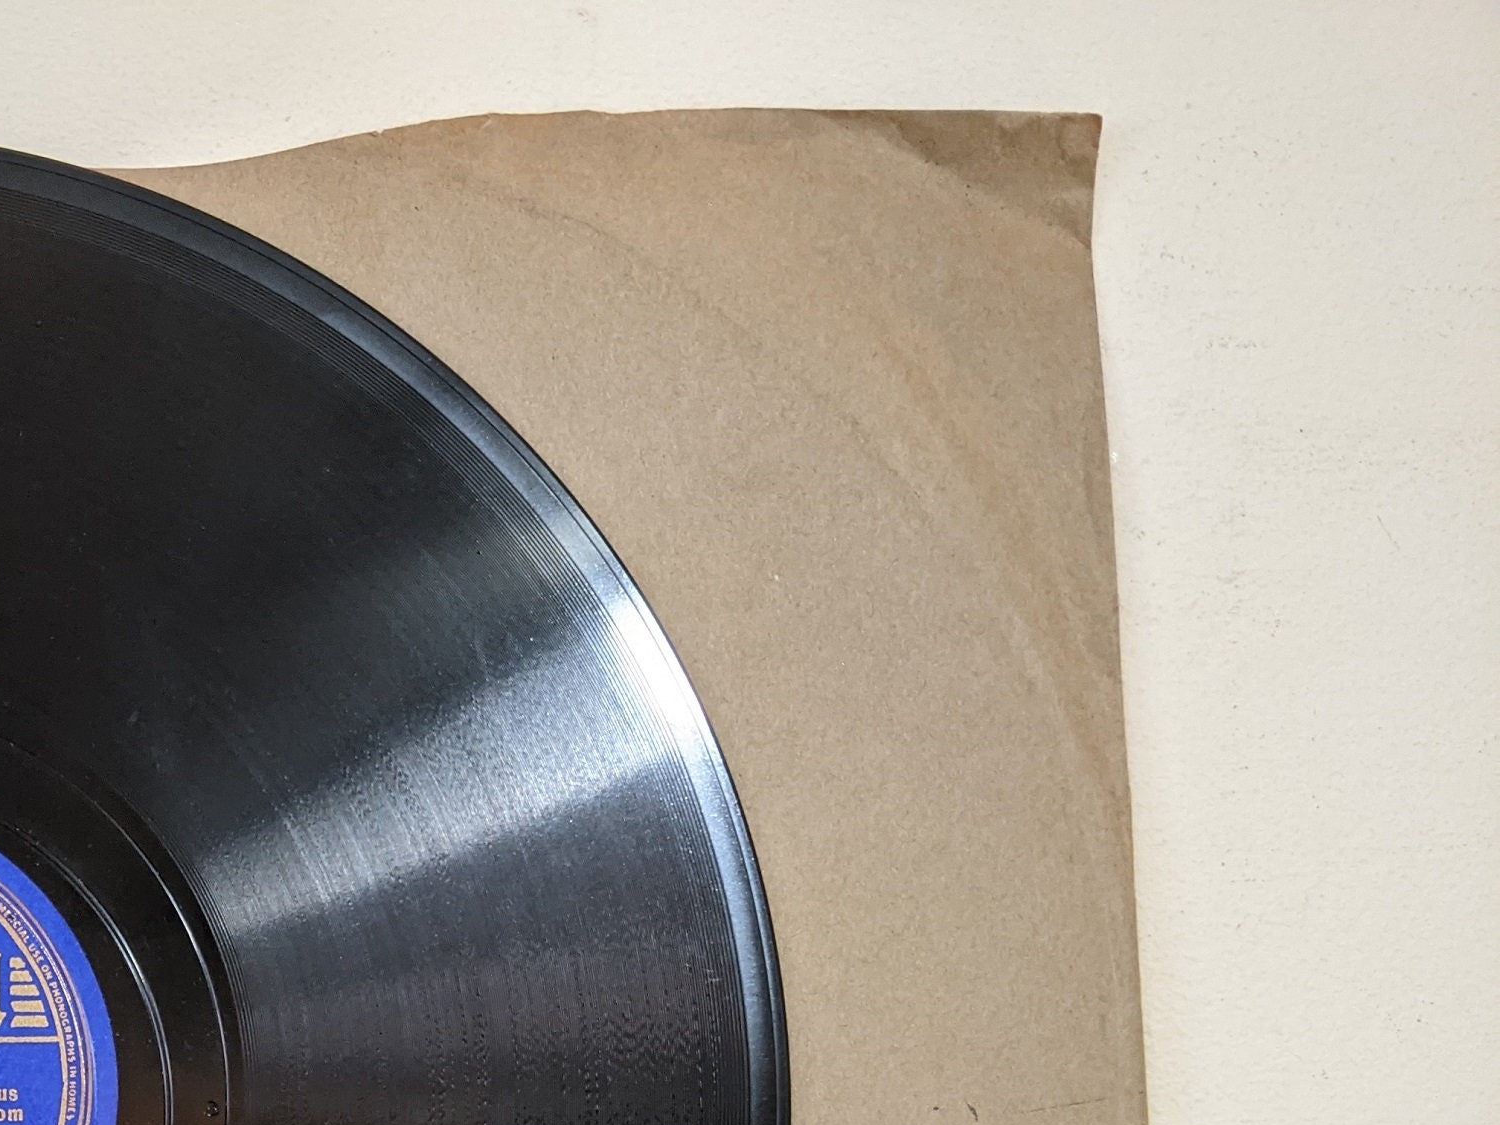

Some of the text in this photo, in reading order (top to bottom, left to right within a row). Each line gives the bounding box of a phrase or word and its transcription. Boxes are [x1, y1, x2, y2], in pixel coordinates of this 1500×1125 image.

[28, 944, 44, 963] USE
[41, 965, 53, 980] ON
[49, 982, 77, 1063] PHONOGRAPHS
[69, 1066, 77, 1078] IN
